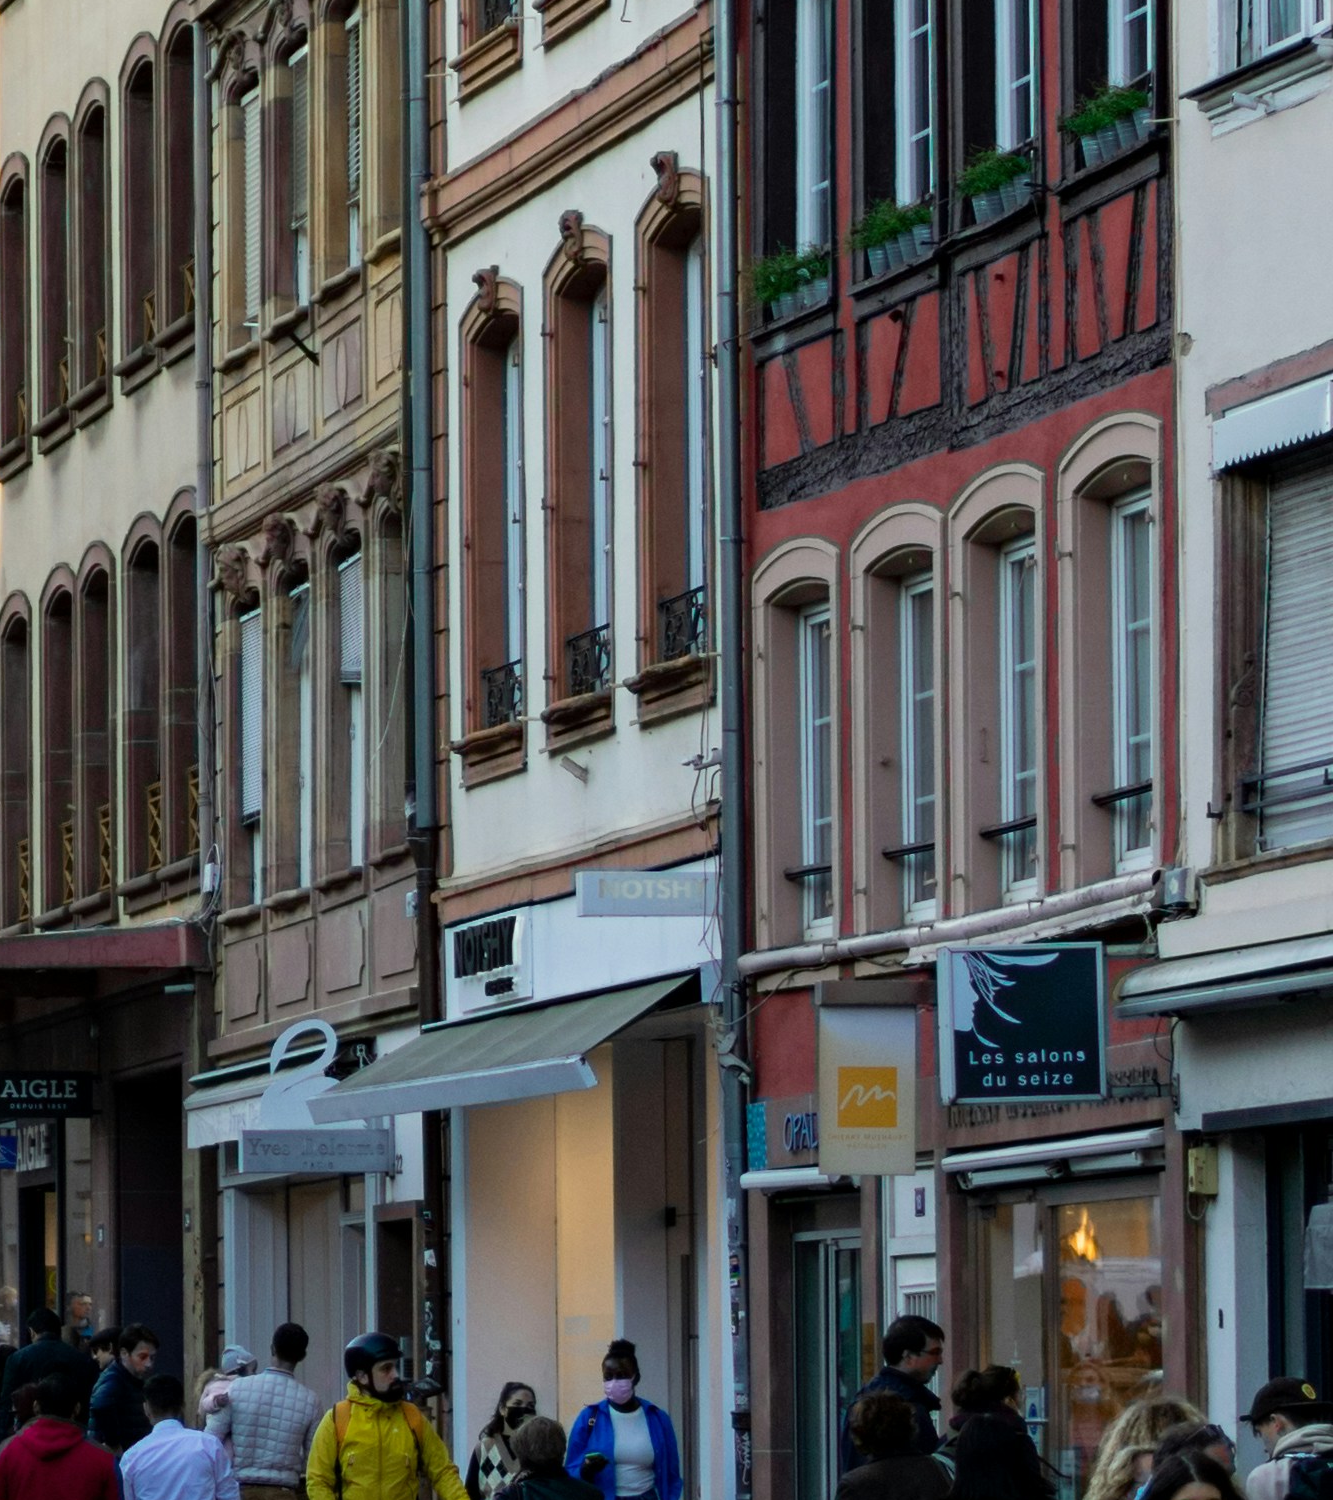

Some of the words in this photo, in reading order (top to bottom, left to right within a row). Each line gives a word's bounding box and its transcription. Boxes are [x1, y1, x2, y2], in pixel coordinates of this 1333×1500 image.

[454, 916, 516, 978] NOTSHY
[969, 1051, 1004, 1066] Les
[1015, 1049, 1086, 1064] salons
[0, 1079, 77, 1099] AIGLE
[982, 1073, 1006, 1087] du
[1018, 1072, 1074, 1086] seize
[246, 1137, 291, 1157] Yves
